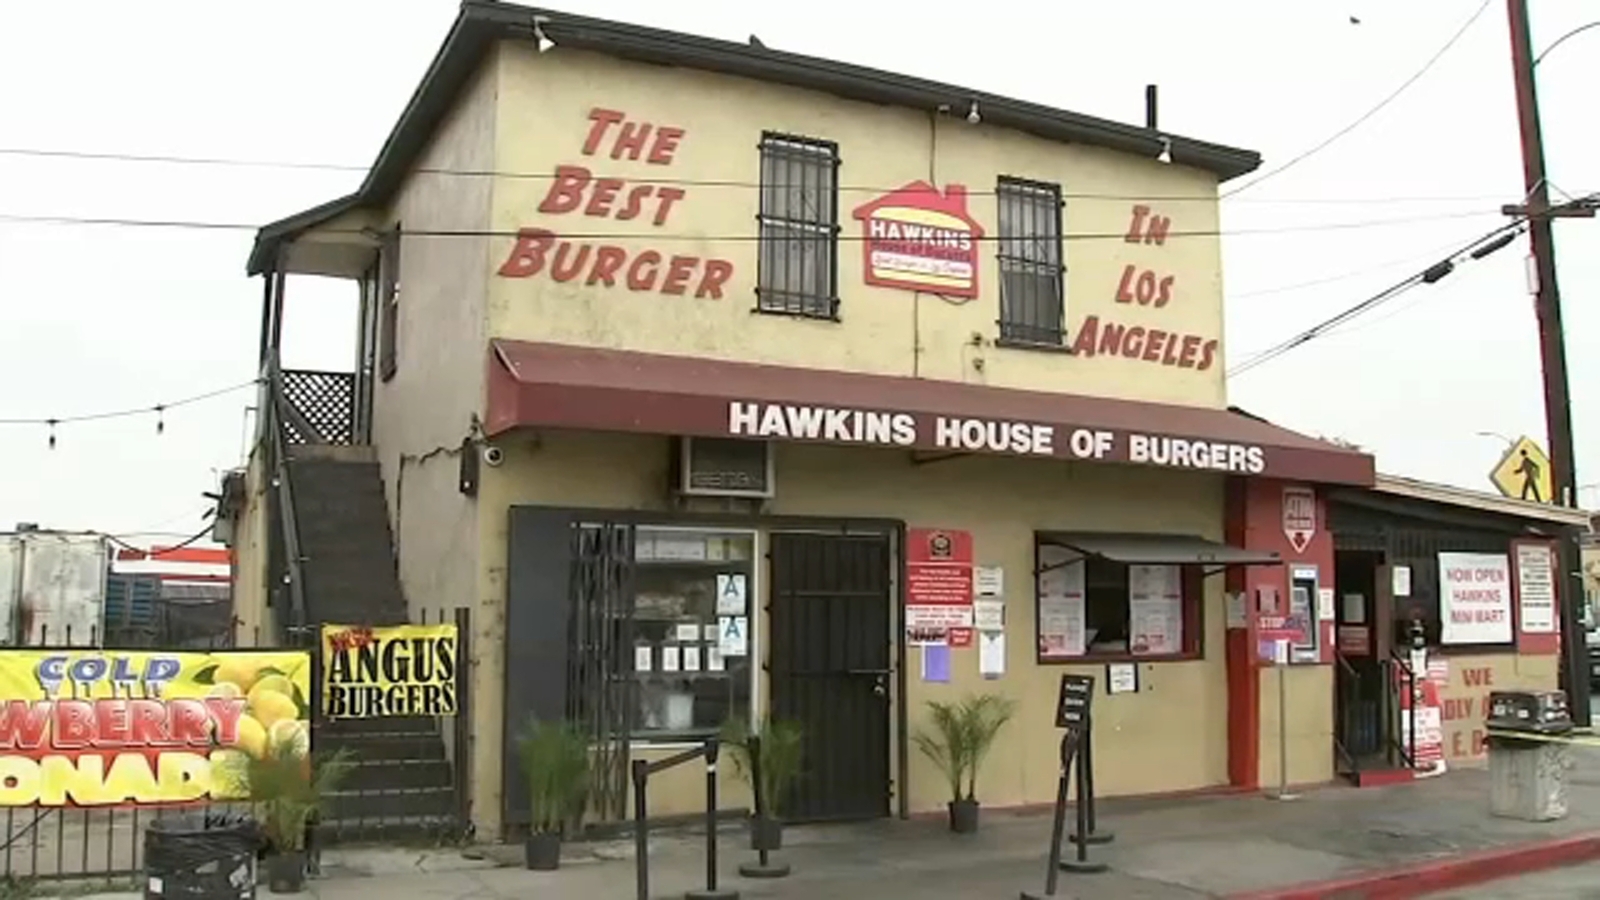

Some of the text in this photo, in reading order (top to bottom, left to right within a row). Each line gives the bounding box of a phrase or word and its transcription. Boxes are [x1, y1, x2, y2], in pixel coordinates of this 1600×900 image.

[581, 107, 686, 166] THE
[537, 165, 685, 227] BEST
[870, 220, 971, 251] HAWKINS
[1124, 204, 1170, 246] IN
[497, 227, 735, 300] BURGER
[1114, 265, 1174, 308] LOS
[1072, 315, 1218, 371] ANGELES
[729, 401, 1265, 474] HAWKINS HOUSE OF BURGERS
[1446, 567, 1505, 582] NOW OPEN
[1453, 589, 1501, 603] HAWKINS
[1475, 609, 1505, 623] MART
[36, 656, 181, 682] COLD
[328, 637, 454, 683] ANGUS
[1462, 668, 1493, 687] WE
[327, 682, 454, 716] BURGERS
